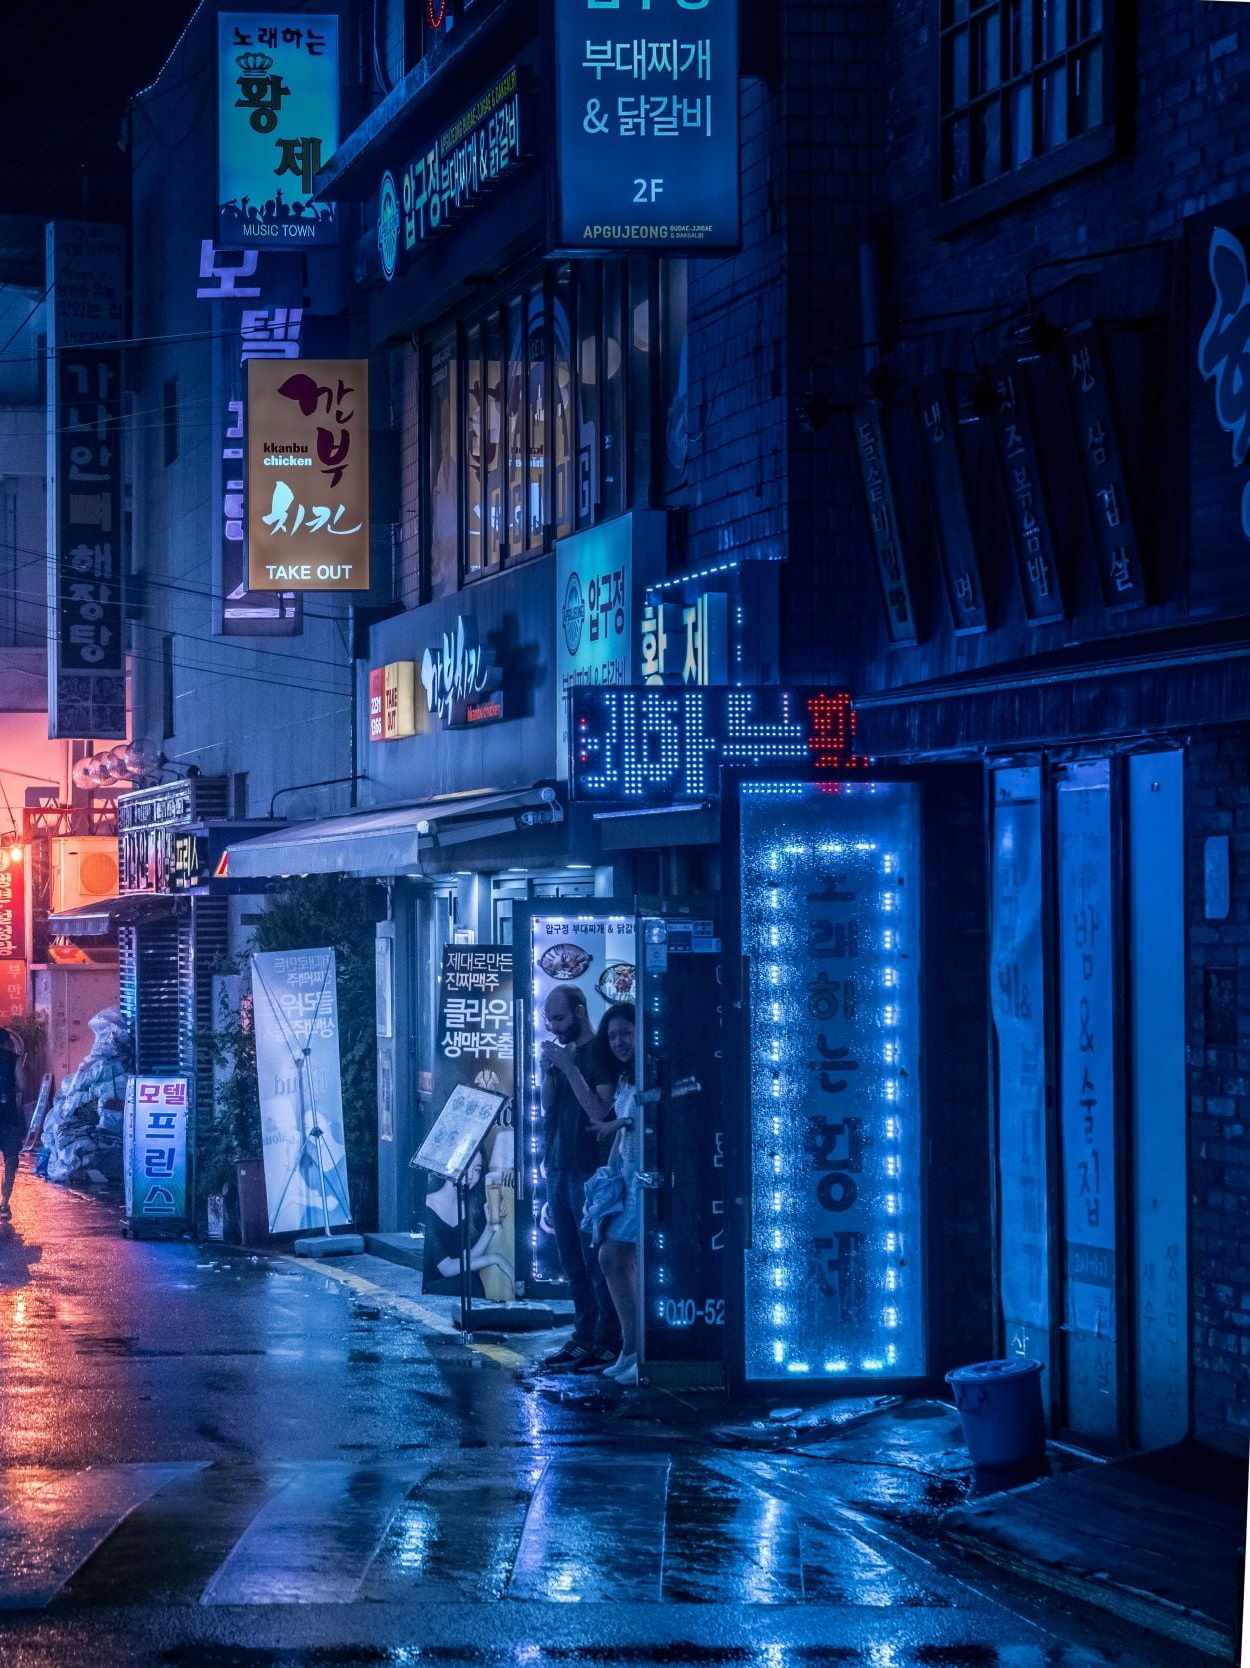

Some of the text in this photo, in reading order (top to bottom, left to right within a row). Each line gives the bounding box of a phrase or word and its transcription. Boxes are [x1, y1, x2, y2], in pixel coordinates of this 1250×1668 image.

[233, 26, 326, 56] 노래하는
[582, 39, 711, 80] 부대찌개
[583, 95, 711, 136] & 닭갈비
[234, 74, 323, 194] 황제
[403, 140, 440, 250] 압구정
[441, 131, 478, 218] 부대찌개
[479, 129, 489, 182] &
[489, 93, 520, 178] 닭갈비
[633, 179, 664, 202] 2F
[243, 224, 316, 238] MUSIC TOWN
[583, 226, 668, 239] APGUJEONG
[277, 373, 355, 489] 깐부
[263, 443, 309, 454] kkanbu
[263, 456, 312, 467] chicken
[262, 481, 363, 536] 치킨
[266, 565, 352, 580] TAKE OUT
[588, 565, 625, 642] 압구정
[641, 592, 709, 686] 황제
[545, 924, 569, 935] 압구정
[607, 926, 614, 935] &
[446, 953, 513, 972] 제대로만든
[445, 972, 500, 991] 진짜맥주
[443, 999, 513, 1029] 클라우
[139, 1083, 185, 1105] 모텔
[143, 1112, 177, 1213] 프린스
